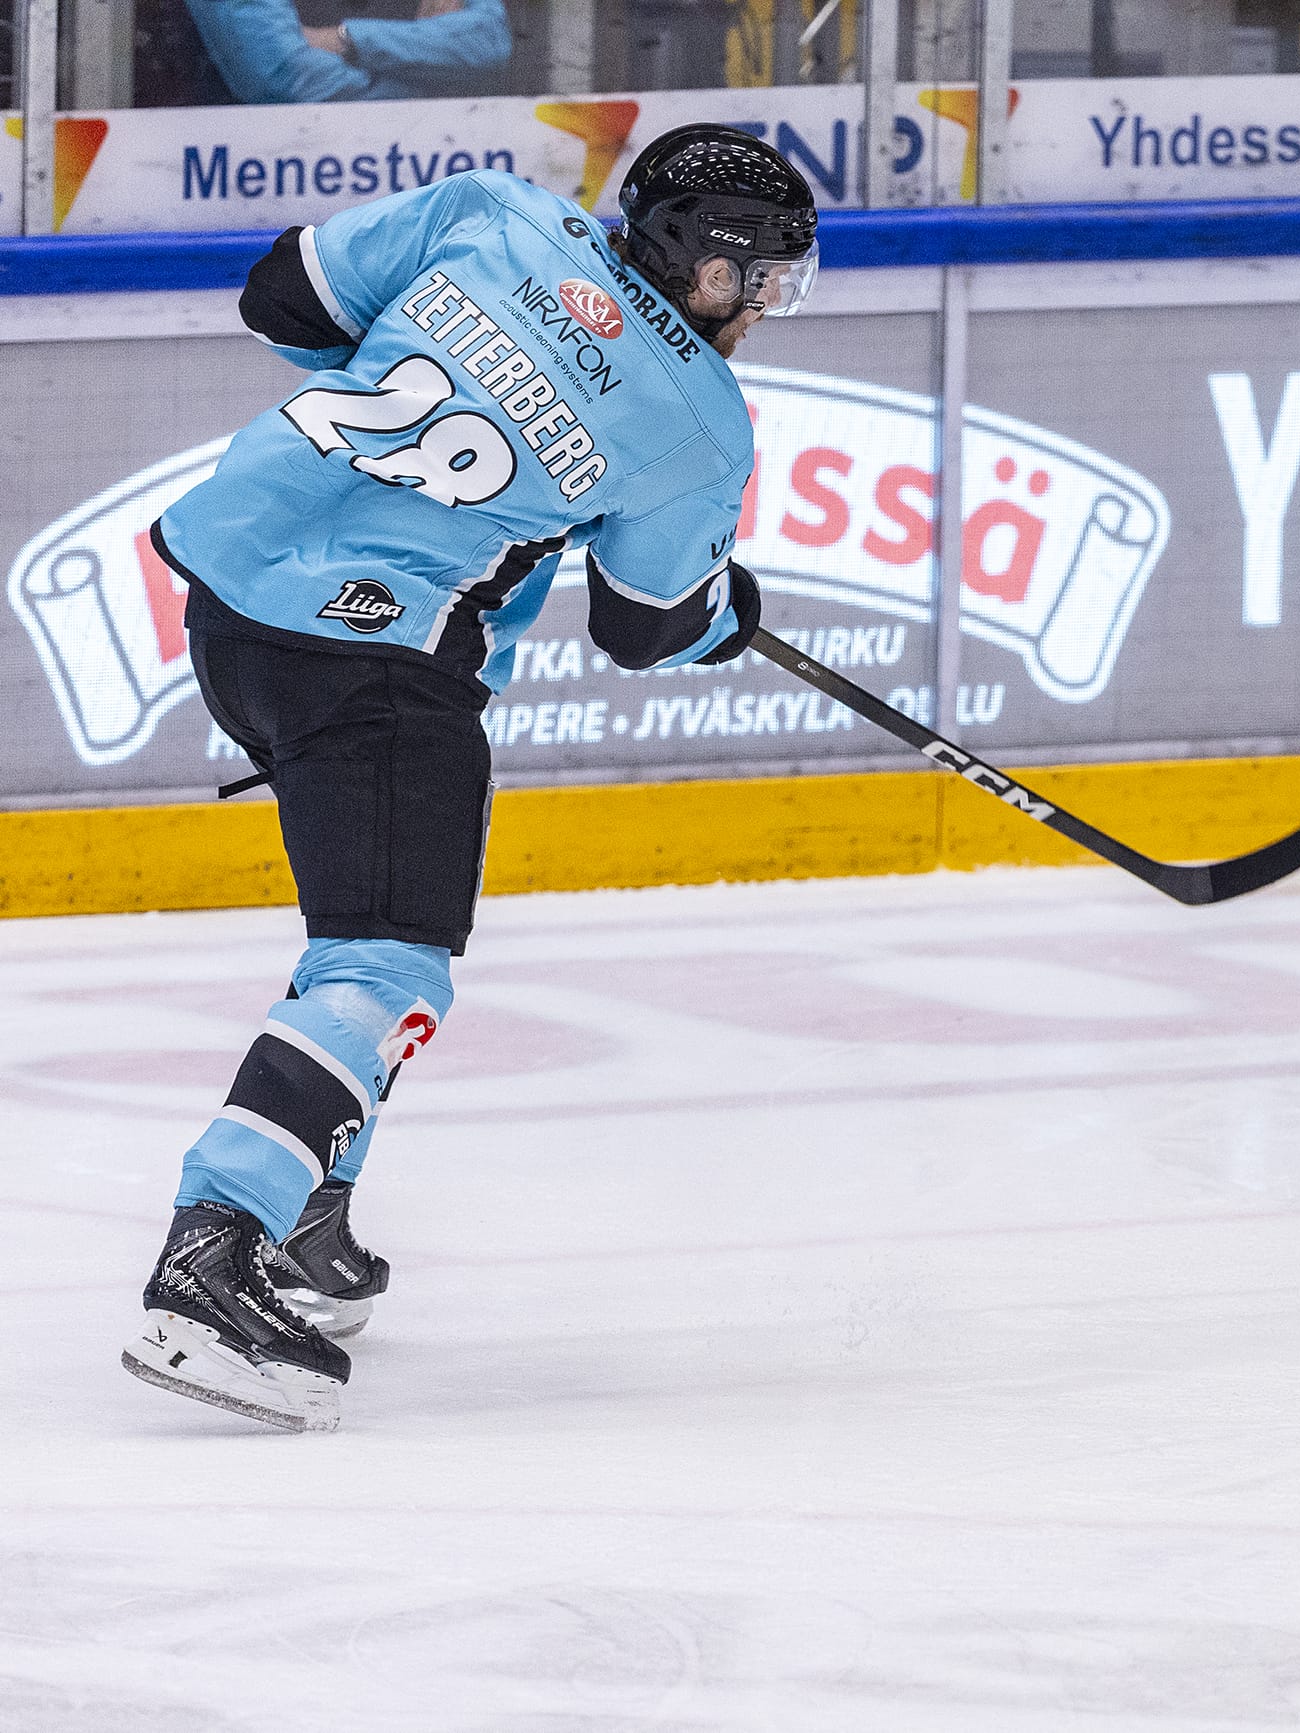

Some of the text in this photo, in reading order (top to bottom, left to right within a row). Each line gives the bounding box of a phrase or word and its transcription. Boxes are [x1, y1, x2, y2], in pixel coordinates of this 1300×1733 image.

[723, 118, 923, 201] NP
[709, 228, 751, 246] CCM
[499, 300, 530, 331] acoustic
[529, 327, 563, 366] cleaning
[560, 362, 594, 405] systems
[512, 277, 623, 396] NIRAFON
[279, 354, 518, 509] 28
[401, 271, 608, 503] ZETTERBERG
[482, 701, 609, 746] MPERE
[920, 739, 1057, 822] CCM
